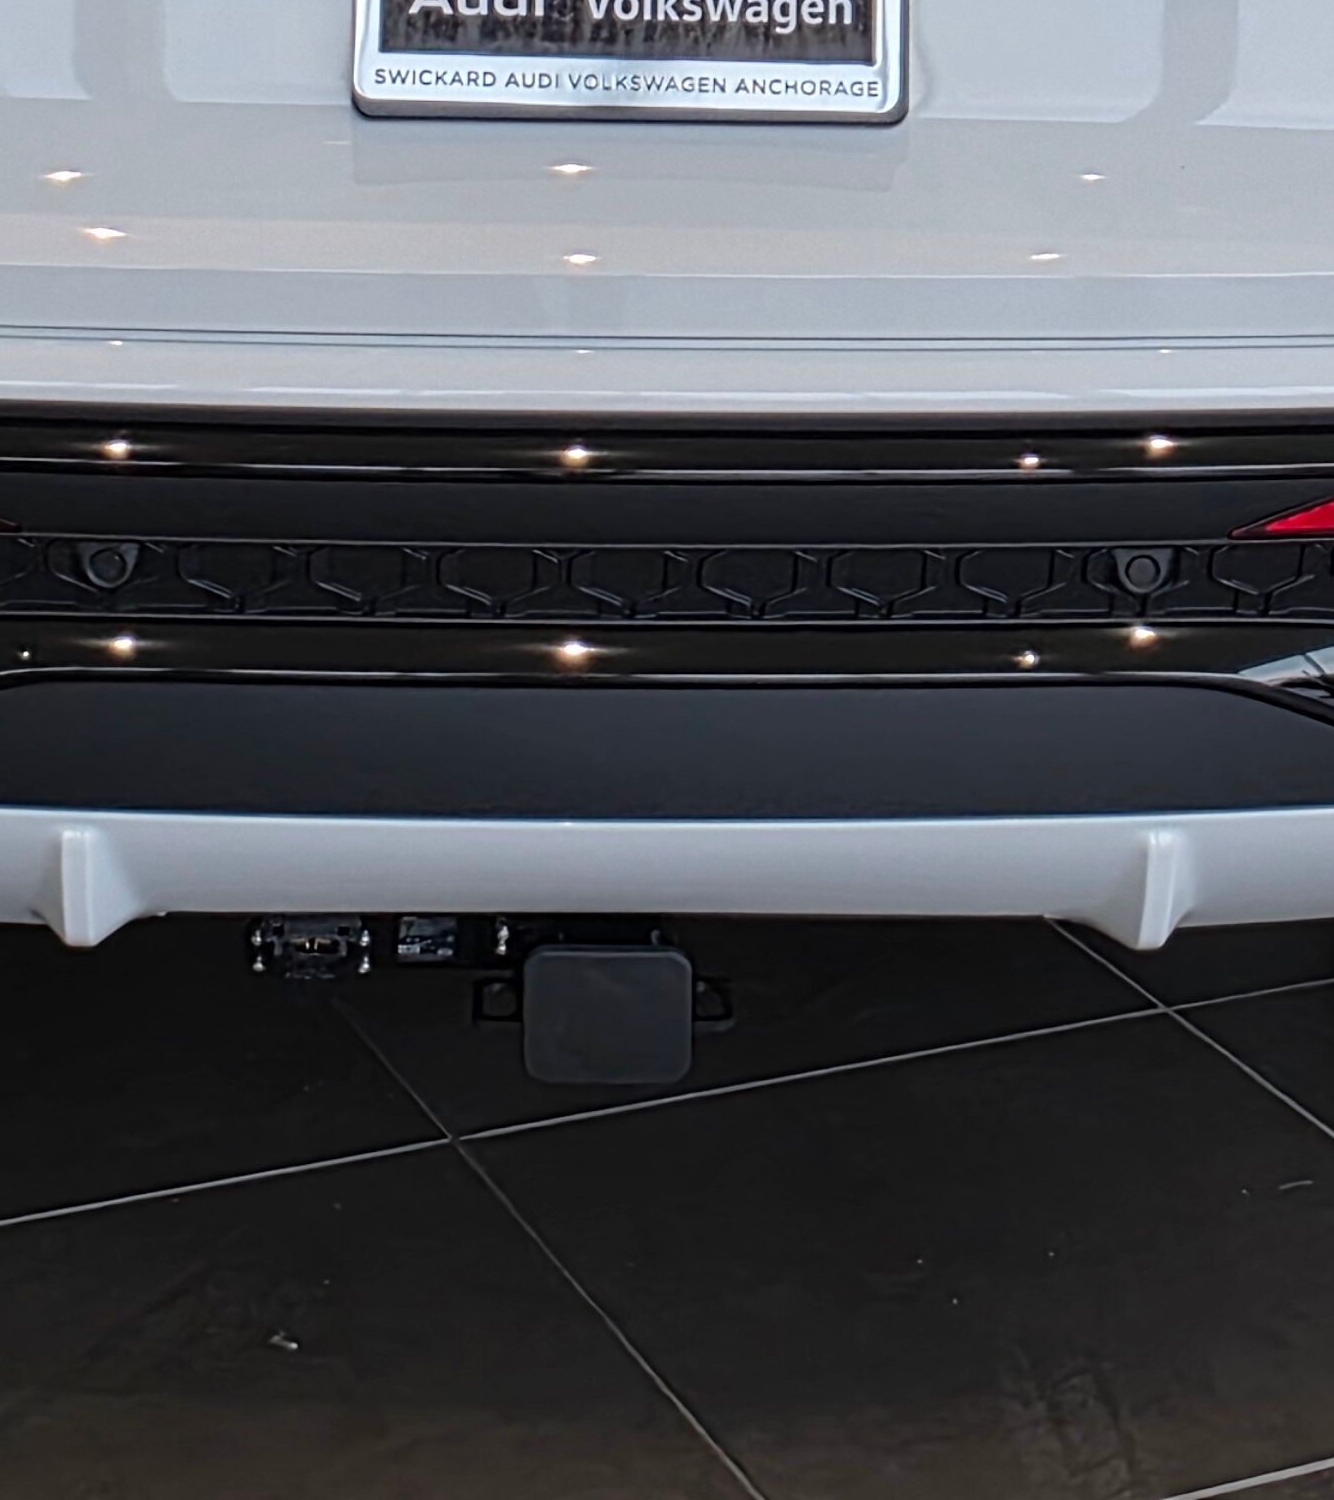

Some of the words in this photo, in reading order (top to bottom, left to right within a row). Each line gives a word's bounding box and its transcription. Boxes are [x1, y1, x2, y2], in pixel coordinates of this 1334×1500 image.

[373, 68, 497, 89] SWICKARD
[504, 71, 560, 90] AUDI
[567, 73, 727, 95] VOLKSWAGEN
[733, 77, 880, 99] ANCHORAGE
